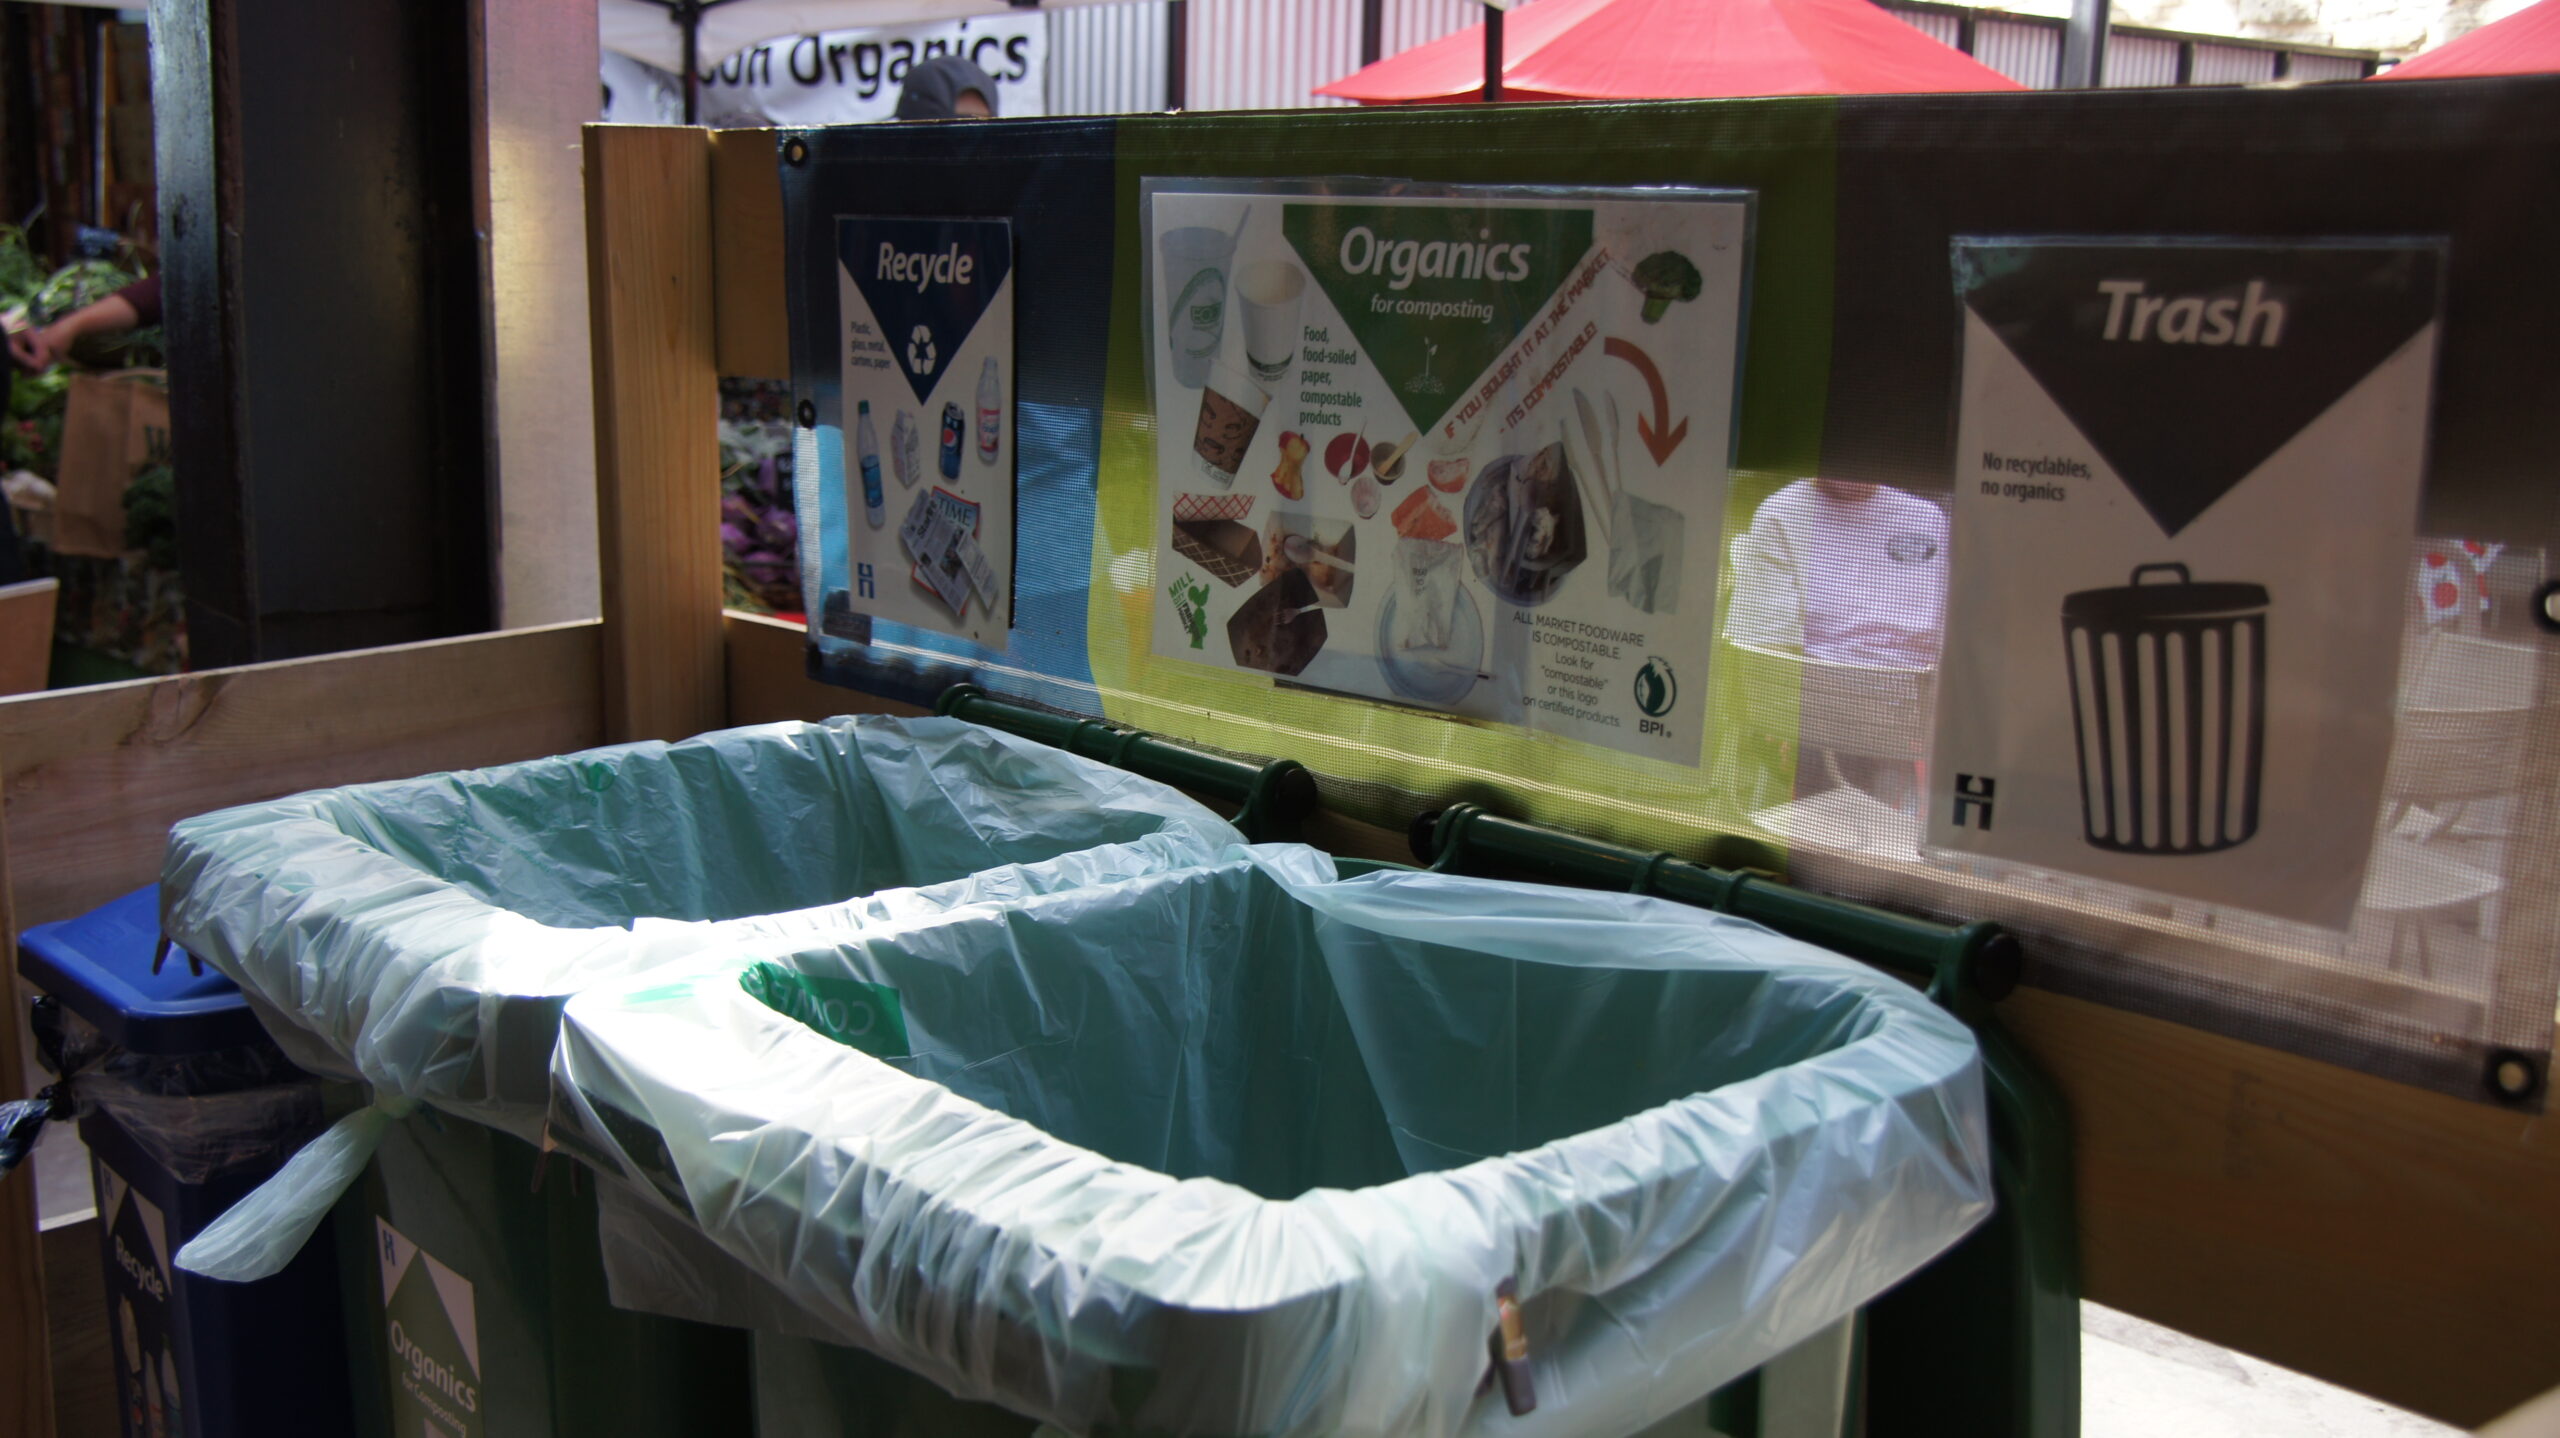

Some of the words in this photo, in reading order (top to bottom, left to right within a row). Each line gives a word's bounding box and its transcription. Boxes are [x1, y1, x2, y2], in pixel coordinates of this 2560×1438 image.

[877, 242, 973, 294] Recycle
[1340, 226, 1532, 291] Organics
[1370, 293, 1395, 313] for
[1396, 299, 1494, 324] composting
[2097, 280, 2286, 347] Trash
[1304, 326, 1330, 344] Food,
[1456, 396, 1481, 425] YOU
[1481, 352, 1522, 402] BOUGHT
[1522, 337, 1535, 357] IT
[1535, 323, 1551, 345] AT
[1548, 298, 1571, 327] THE
[1566, 247, 1611, 304] MARKET
[1302, 346, 1357, 365] food-soiled
[1523, 320, 1598, 410] COMPOSTABLE!
[1301, 370, 1332, 386] paper,
[1300, 391, 1362, 408] compostable
[1299, 410, 1342, 426] products
[1982, 452, 2001, 471] No
[2006, 456, 2091, 481] recyclables,
[1981, 481, 2000, 496] no
[2003, 482, 2066, 503] organics
[937, 497, 972, 526] TIME
[1168, 571, 1194, 598] MILL
[1513, 611, 1533, 625] ALL
[1536, 615, 1577, 633] MARKET
[1579, 623, 1645, 647] FOODWARE
[1532, 631, 1542, 643] IS
[1543, 632, 1621, 659] COMPOSTABLE.
[1555, 652, 1578, 667] Look
[1580, 657, 1594, 671] for
[1548, 684, 1558, 696] or
[1559, 686, 1576, 700] this
[1577, 690, 1599, 706] logo
[1522, 696, 1537, 707] on
[1538, 699, 1575, 717] certified
[1576, 706, 1621, 728] products.
[115, 1235, 165, 1303] Recycle
[390, 1320, 476, 1413] Organics
